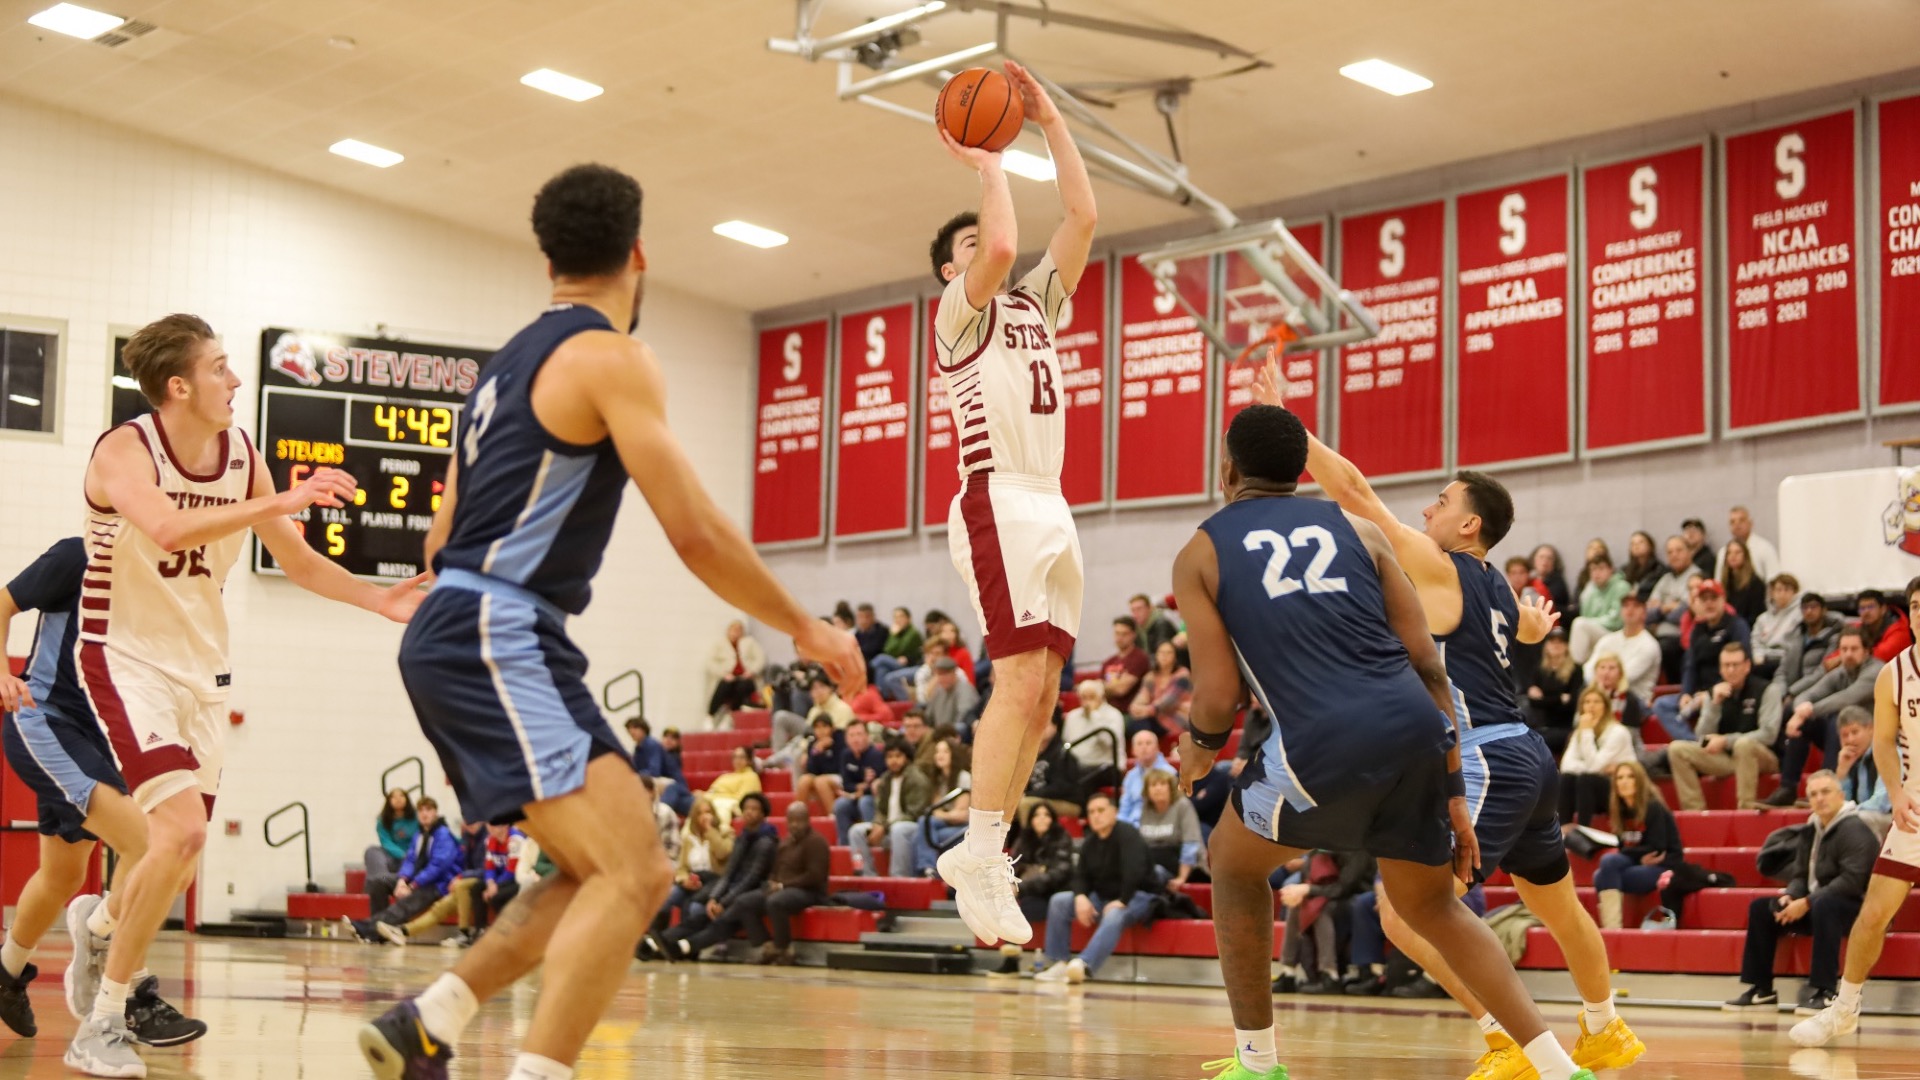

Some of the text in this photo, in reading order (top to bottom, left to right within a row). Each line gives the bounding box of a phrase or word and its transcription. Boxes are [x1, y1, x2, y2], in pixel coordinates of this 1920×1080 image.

[1775, 133, 1805, 200] S
[1629, 165, 1658, 230] S
[1752, 200, 1828, 230] FIELD HOCKEY
[1499, 193, 1526, 256] S
[1762, 223, 1820, 257] NCAA
[1379, 218, 1405, 279] S
[1592, 248, 1695, 286] CONFERENCE
[1736, 243, 1850, 283] APPEARANCES
[1154, 259, 1177, 314] S
[1487, 277, 1538, 309] NCAA
[1592, 270, 1696, 309] CHAMPIONS
[1815, 270, 1848, 293] 2010
[1464, 296, 1563, 331] APPEARANCES
[783, 332, 802, 382] S
[865, 316, 886, 368] S
[323, 346, 480, 395] STEVENS
[1029, 360, 1058, 415] 13
[374, 404, 452, 448] 4:42
[276, 438, 345, 466] STEVENS
[380, 457, 421, 475] PERIOD
[390, 476, 409, 509] 2
[361, 510, 403, 528] PLAYER
[326, 523, 345, 556] 5
[377, 562, 416, 578] MATCH
[1242, 524, 1350, 600] 22
[1489, 606, 1511, 668] 5
